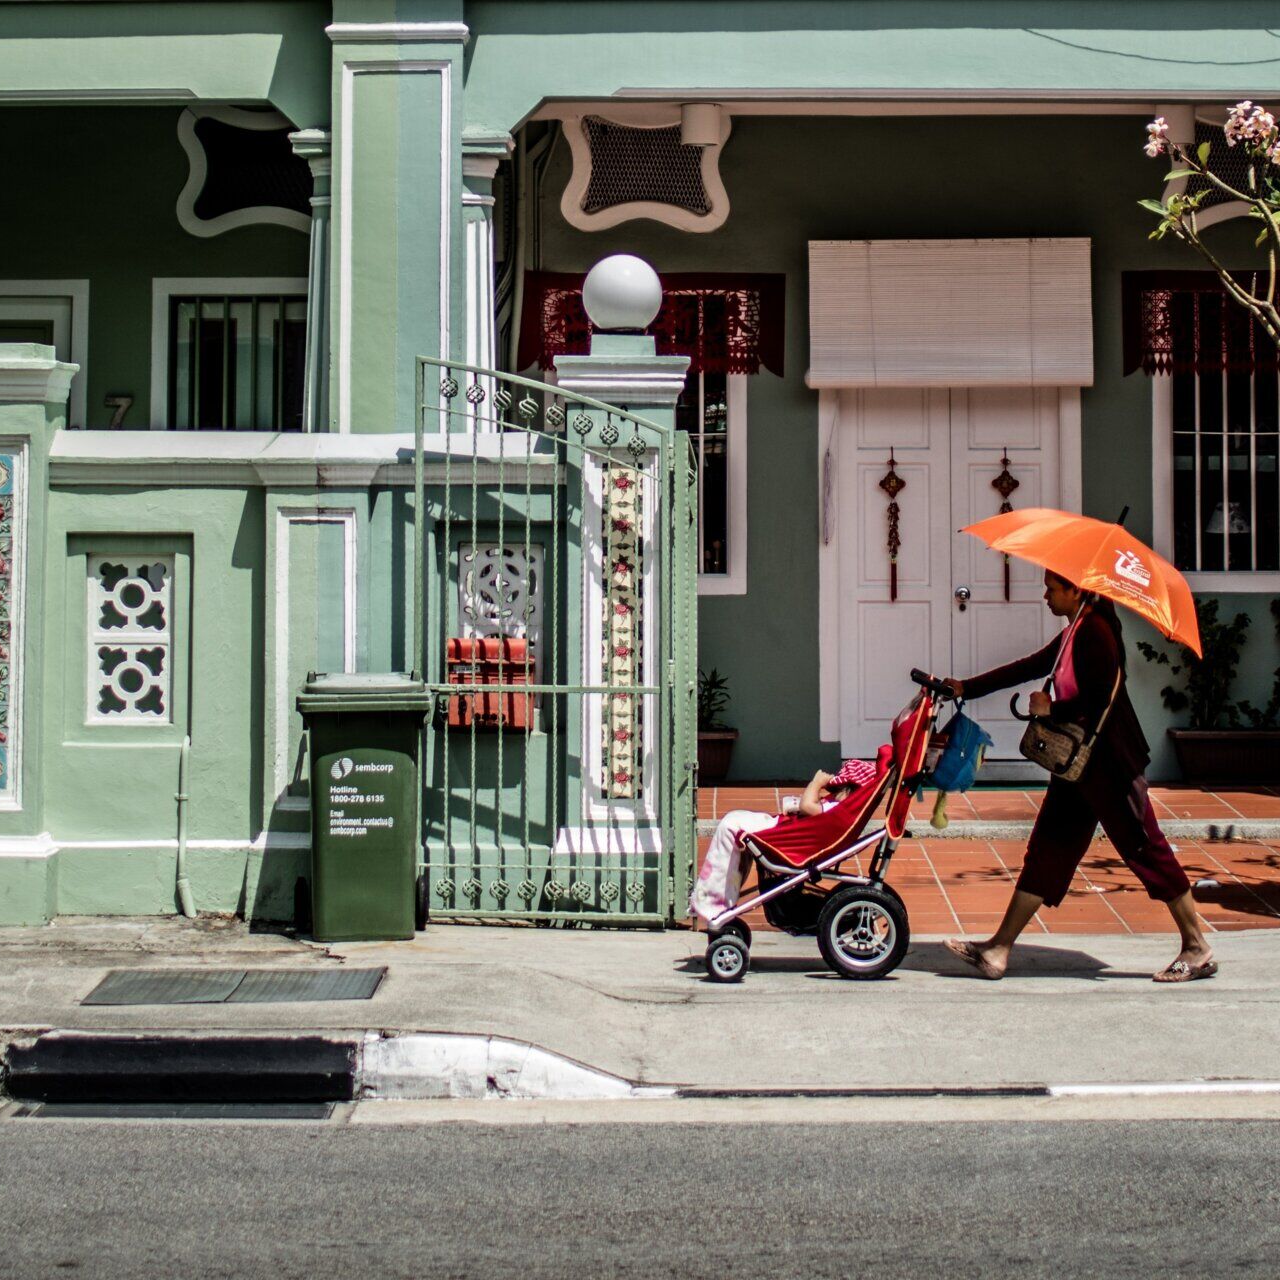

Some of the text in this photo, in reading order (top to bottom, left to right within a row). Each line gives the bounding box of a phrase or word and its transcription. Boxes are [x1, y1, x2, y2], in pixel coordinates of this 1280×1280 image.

[104, 394, 134, 430] 7
[355, 763, 394, 773] sembcorp
[330, 827, 367, 836] sembcorp.com
